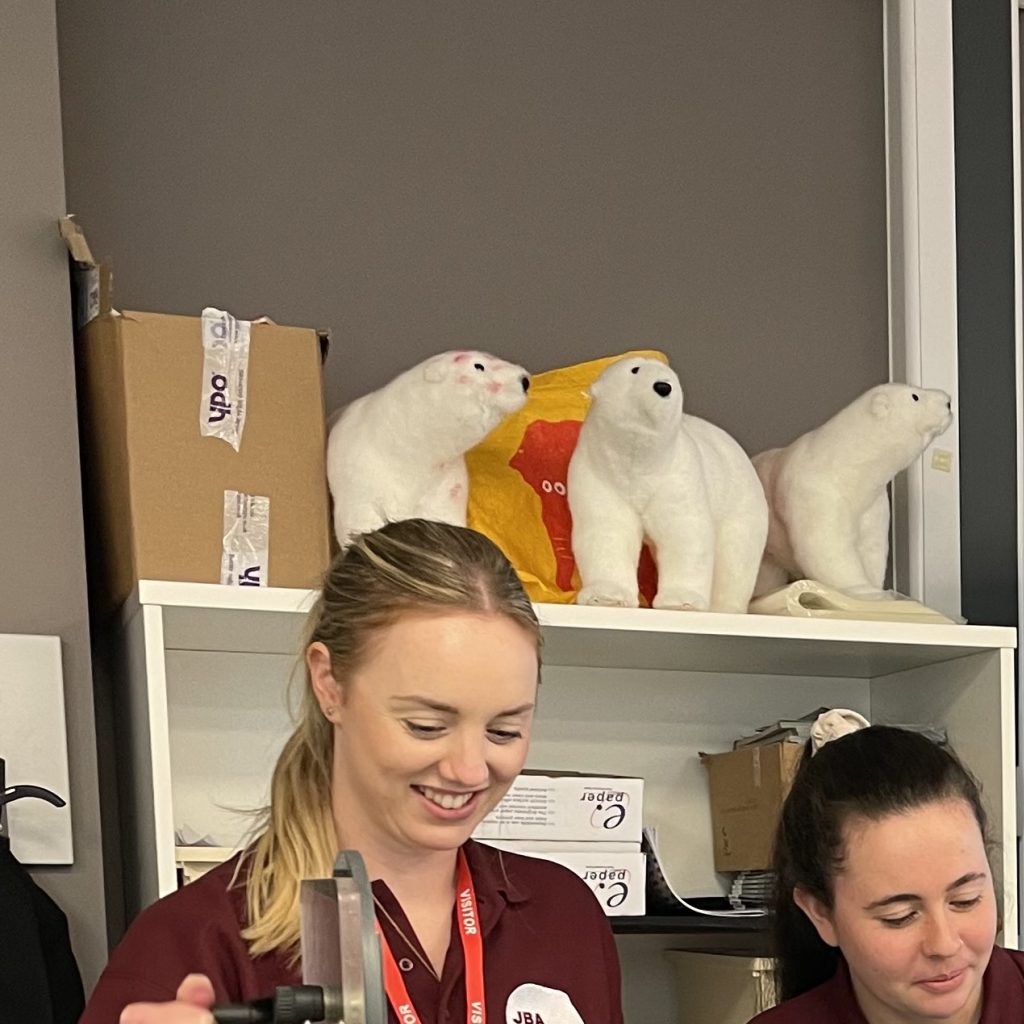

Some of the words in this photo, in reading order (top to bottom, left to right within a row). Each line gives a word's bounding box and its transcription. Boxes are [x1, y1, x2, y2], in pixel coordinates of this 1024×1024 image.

[208, 374, 232, 423] ypo
[579, 791, 625, 802] paper
[583, 870, 627, 881] paper
[459, 888, 478, 935] VISITOR
